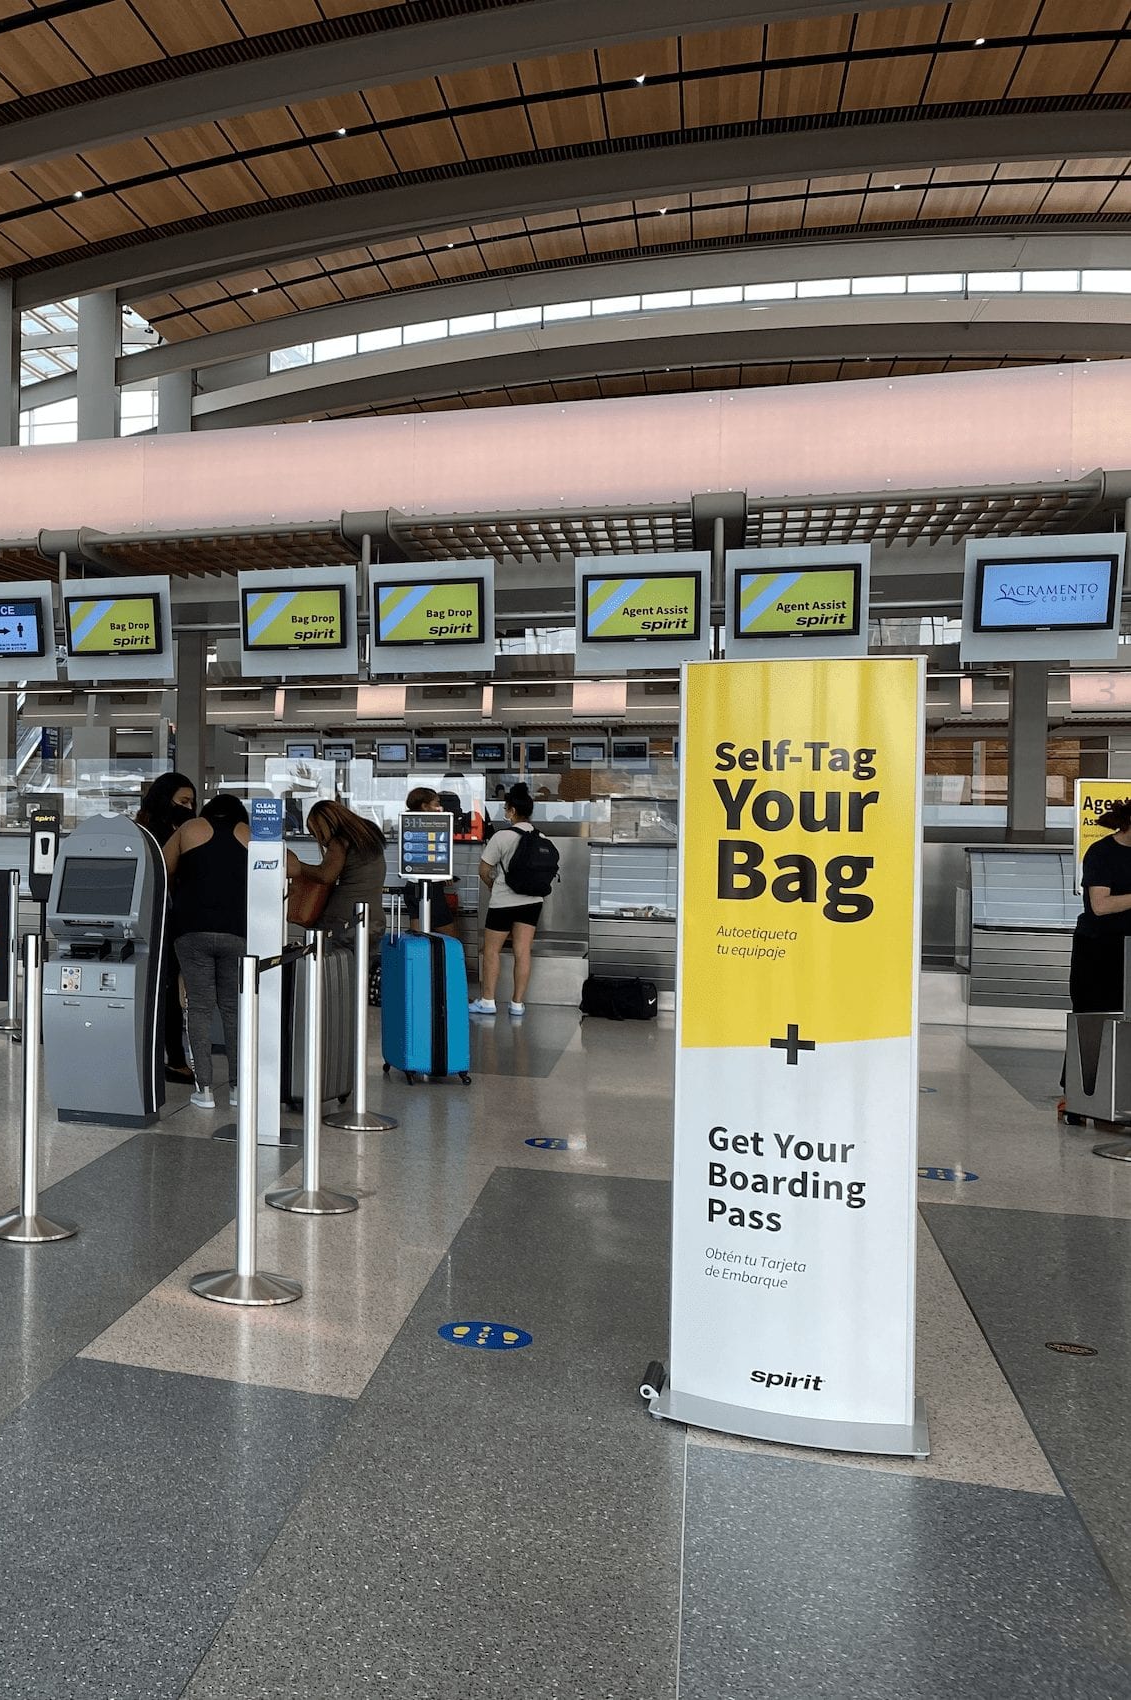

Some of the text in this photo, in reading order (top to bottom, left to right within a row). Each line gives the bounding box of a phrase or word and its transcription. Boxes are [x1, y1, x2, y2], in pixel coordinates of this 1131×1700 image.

[999, 583, 1099, 599] SACRAMENTO
[1041, 595, 1095, 603] COUNTY
[426, 608, 473, 620] Bag Drop
[622, 604, 689, 618] Agent Assist
[776, 600, 847, 614] Agent Assist
[110, 621, 150, 633] Bag Drop
[291, 614, 335, 626] Bag Drop
[640, 618, 689, 633] spirit
[796, 613, 847, 628] spirit
[294, 627, 336, 643] spirit
[428, 623, 474, 638] spirit
[113, 634, 151, 648] spirit
[714, 739, 877, 781] Self-Tag
[712, 778, 879, 833] Your
[35, 815, 56, 823] spirit
[717, 839, 875, 923] Bag
[716, 925, 798, 943] Autoetiqueta
[717, 943, 787, 961] tu equipaje
[708, 1126, 856, 1163] Get Your
[708, 1161, 867, 1209] Boarding
[707, 1198, 782, 1232] Pass
[704, 1246, 807, 1275] Obtén tu Tarjeta
[705, 1264, 789, 1289] de Embarque
[750, 1370, 823, 1391] spirit
